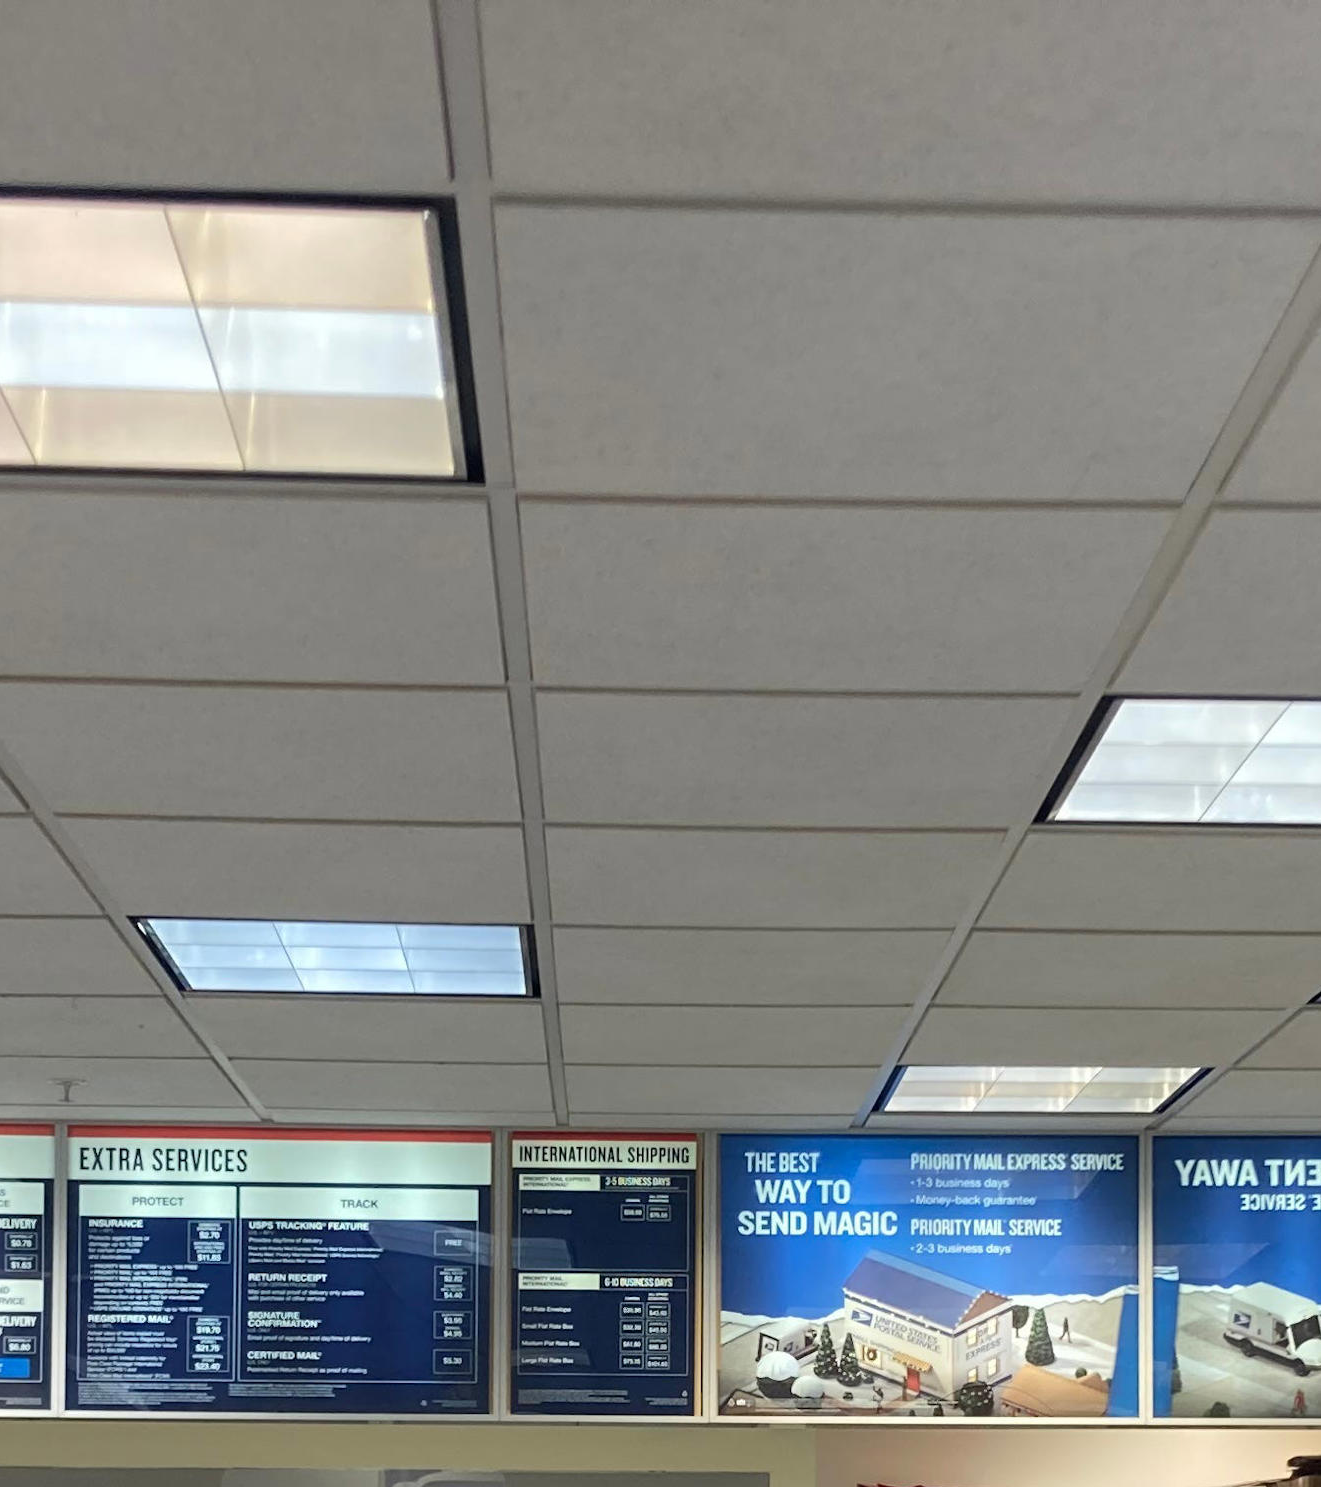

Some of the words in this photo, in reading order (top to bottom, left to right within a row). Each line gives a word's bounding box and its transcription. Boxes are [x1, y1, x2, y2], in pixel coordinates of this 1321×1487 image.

[519, 1145, 623, 1163] INTERNATIONAL
[628, 1147, 690, 1164] SHIPPING
[79, 1147, 144, 1172] EXTRA
[152, 1148, 249, 1174] SERVICES
[745, 1152, 776, 1173] THE
[779, 1152, 821, 1173] BEST
[910, 1153, 972, 1171] PRIORITY
[973, 1153, 1006, 1171] MAIL
[1070, 1153, 1125, 1171] SERVICE
[604, 1176, 617, 1186] 3-5
[618, 1176, 652, 1186] BUSINESS
[653, 1177, 671, 1186] DAYS
[935, 1177, 982, 1188] business
[755, 1180, 812, 1204] WAY
[817, 1180, 851, 1204] TO
[132, 1197, 184, 1207] PROTECT
[340, 1199, 379, 1209] TRACK
[916, 1195, 981, 1207] Money-back
[88, 1219, 144, 1228] INSURANCE
[248, 1221, 275, 1230] USPS
[327, 1222, 369, 1231] FEATURE
[738, 1211, 807, 1236] SEND
[813, 1211, 898, 1237] MAGIC
[910, 1219, 972, 1236] PRIORITY
[1009, 1219, 1062, 1236] SERVICE
[916, 1244, 935, 1254] 2-3
[937, 1244, 983, 1255] business
[248, 1273, 286, 1282] RETURN
[288, 1273, 327, 1283] RECEIPT
[620, 1278, 654, 1287] BUSINESS
[655, 1278, 673, 1288] DAYS
[248, 1311, 300, 1320] SIGNATURE
